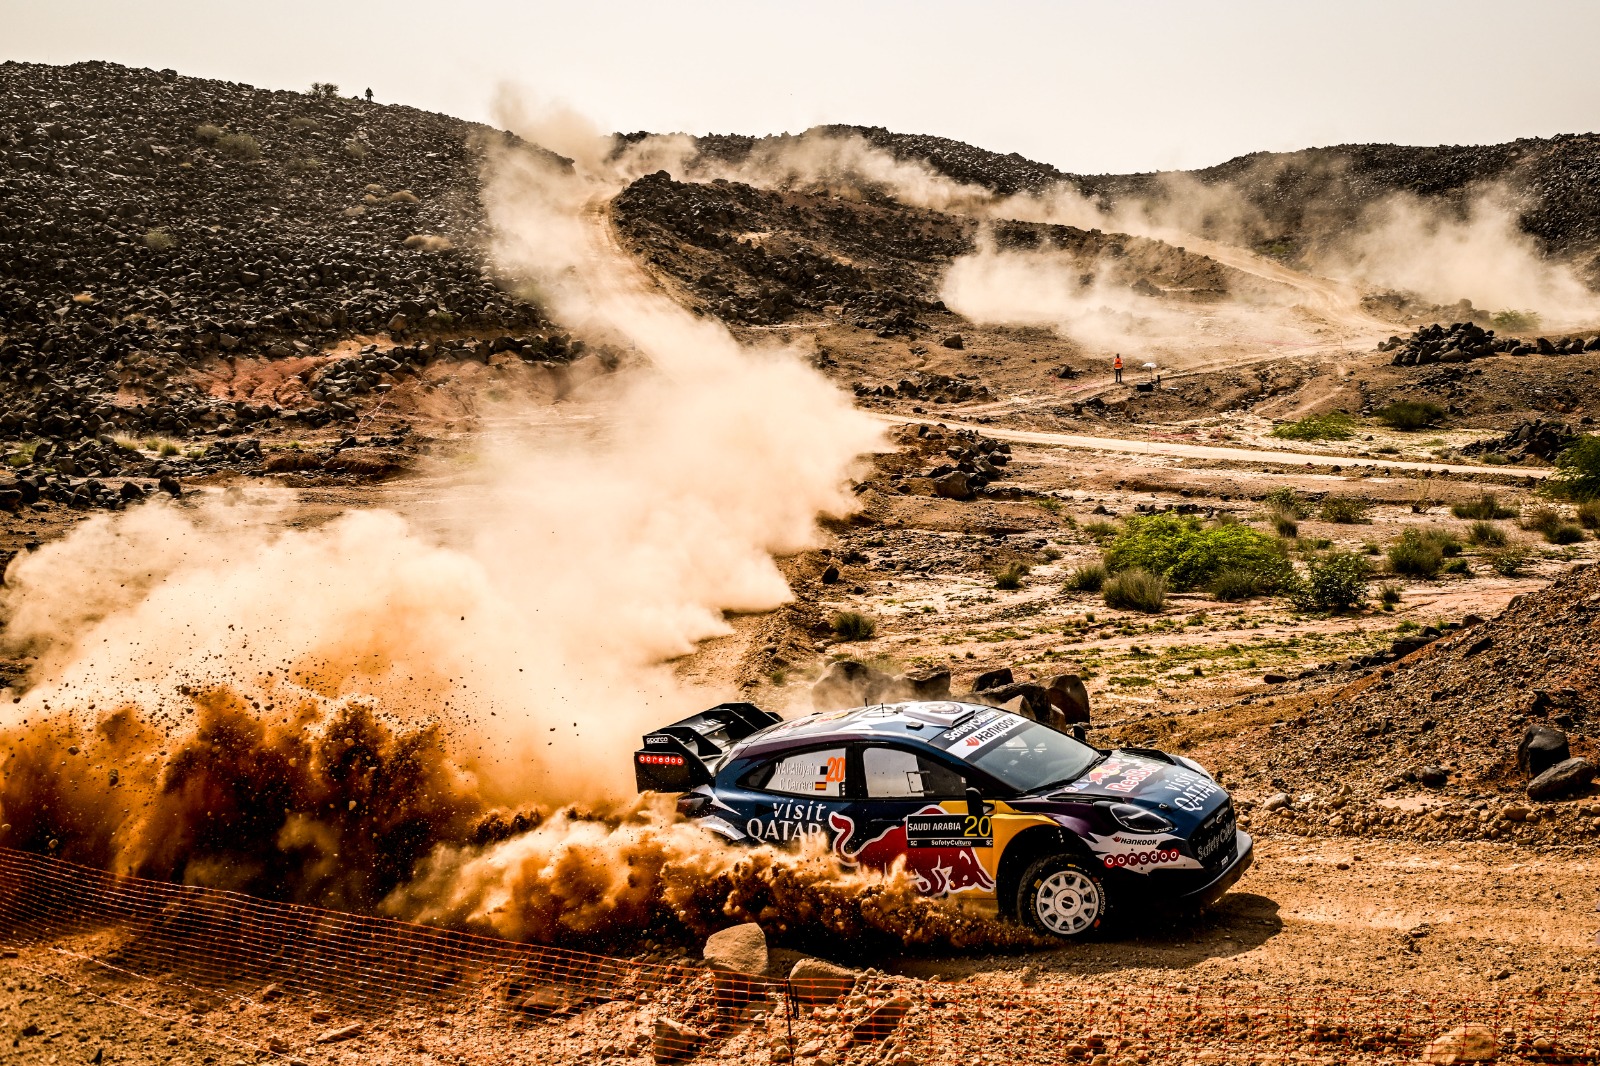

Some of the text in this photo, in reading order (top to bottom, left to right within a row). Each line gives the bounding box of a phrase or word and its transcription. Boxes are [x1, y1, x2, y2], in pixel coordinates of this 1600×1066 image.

[640, 755, 683, 765] ooredoo
[826, 756, 846, 782] 20
[1165, 772, 1198, 792] visit
[1174, 780, 1220, 812] QATAR
[772, 799, 827, 821] visit
[746, 817, 821, 844] QATAR
[908, 821, 961, 831] SAUDI ARABIA
[963, 815, 992, 837] 20
[1105, 849, 1178, 867] ooredoo
